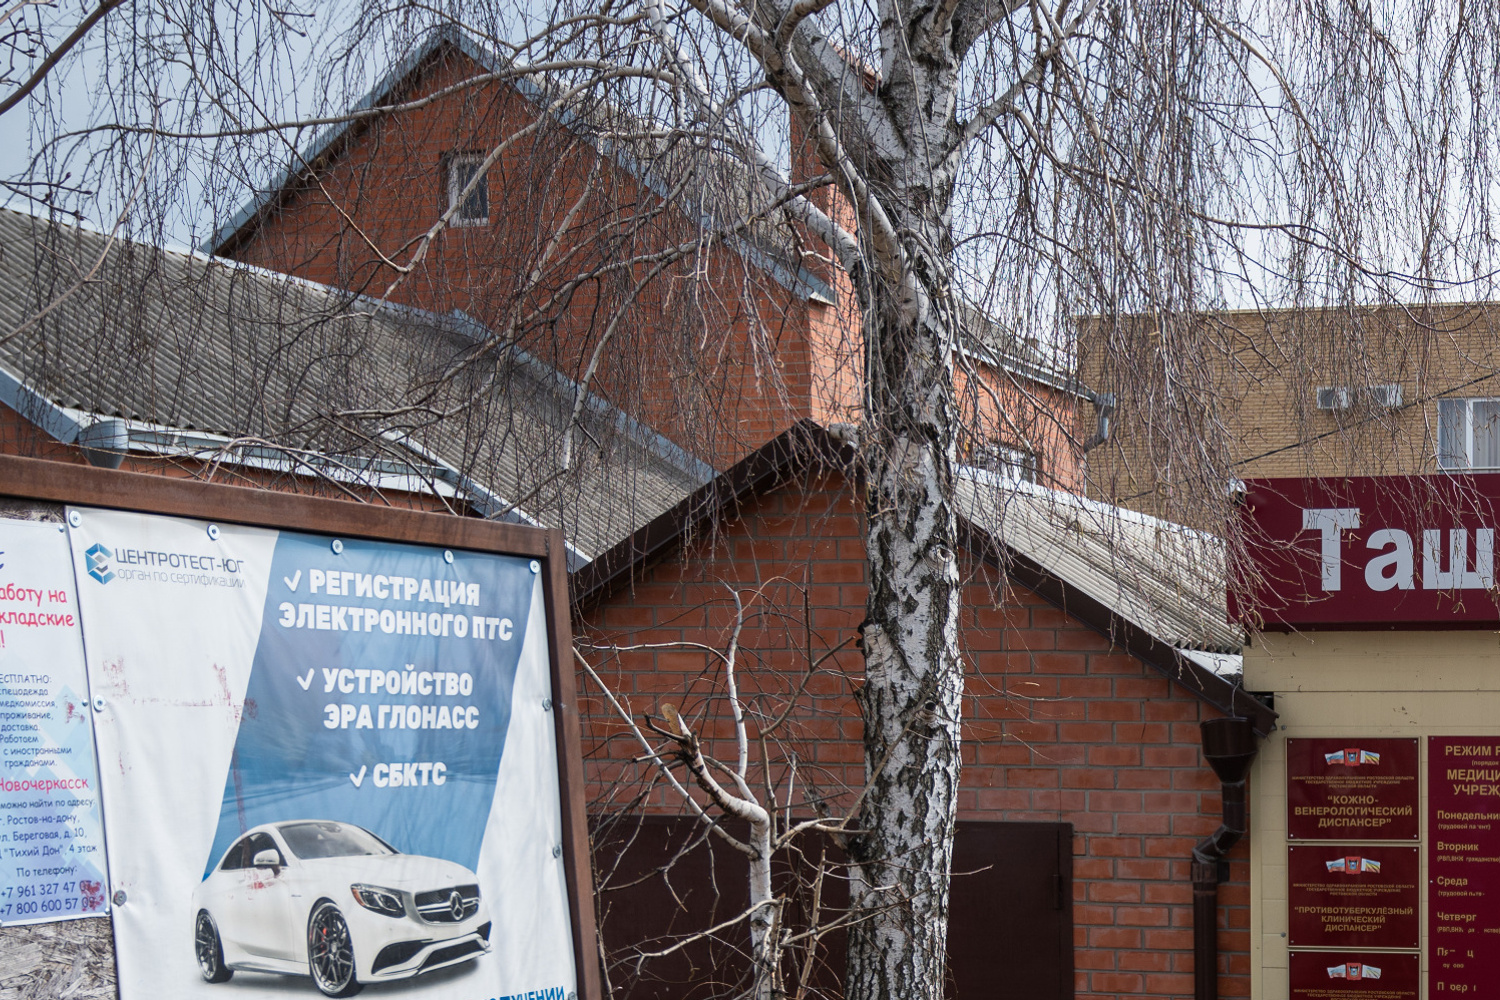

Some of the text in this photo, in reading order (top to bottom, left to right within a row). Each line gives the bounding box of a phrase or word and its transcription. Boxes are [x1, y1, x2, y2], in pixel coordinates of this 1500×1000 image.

[114, 548, 244, 574] ЦЕНТРОТЕСТ-ЮГ
[118, 568, 246, 589] орган по сертификации
[309, 569, 480, 608] РЕГИСТРАЦИЯ
[48, 590, 67, 603] на
[278, 602, 514, 641] ЭЛЕКТРОННОГО ПТС
[321, 664, 473, 697] УСТРОЙСТВО
[323, 703, 480, 729] ЭРА ГЛОНАСС
[3, 747, 72, 758] с иностранными
[1445, 746, 1492, 756] РЕЖИМ
[4, 760, 58, 770] гражданами.
[372, 762, 447, 788] СБКТС
[0, 777, 89, 795] Новочеркасск
[29, 798, 53, 808] найти
[55, 799, 66, 808] по
[67, 797, 95, 810] адресу:
[1327, 795, 1379, 805] "КОЖНО-
[1294, 805, 1413, 816] ВЕНЕРОЛОГИЧЕСКИЙ
[6, 813, 80, 827] Ростов-на-дону,
[1318, 818, 1391, 828] ДИСПАНСЕР"
[12, 827, 88, 844] Береговая, д. 10,
[4, 846, 41, 859] "Тихий
[69, 845, 75, 853] 4
[1437, 841, 1479, 853] Вторник
[16, 865, 78, 879] По телефону:
[1436, 876, 1468, 887] Среда
[1, 886, 14, 899] +7
[16, 885, 37, 898] 961
[39, 882, 60, 896] 327
[62, 881, 77, 893] 47
[0, 898, 78, 916] +7 800 600 57
[1321, 915, 1386, 924] КЛИНИЧЕСКИЙ
[1437, 911, 1477, 923] Четверг
[1324, 924, 1382, 932] ДИСПАНСЕР"
